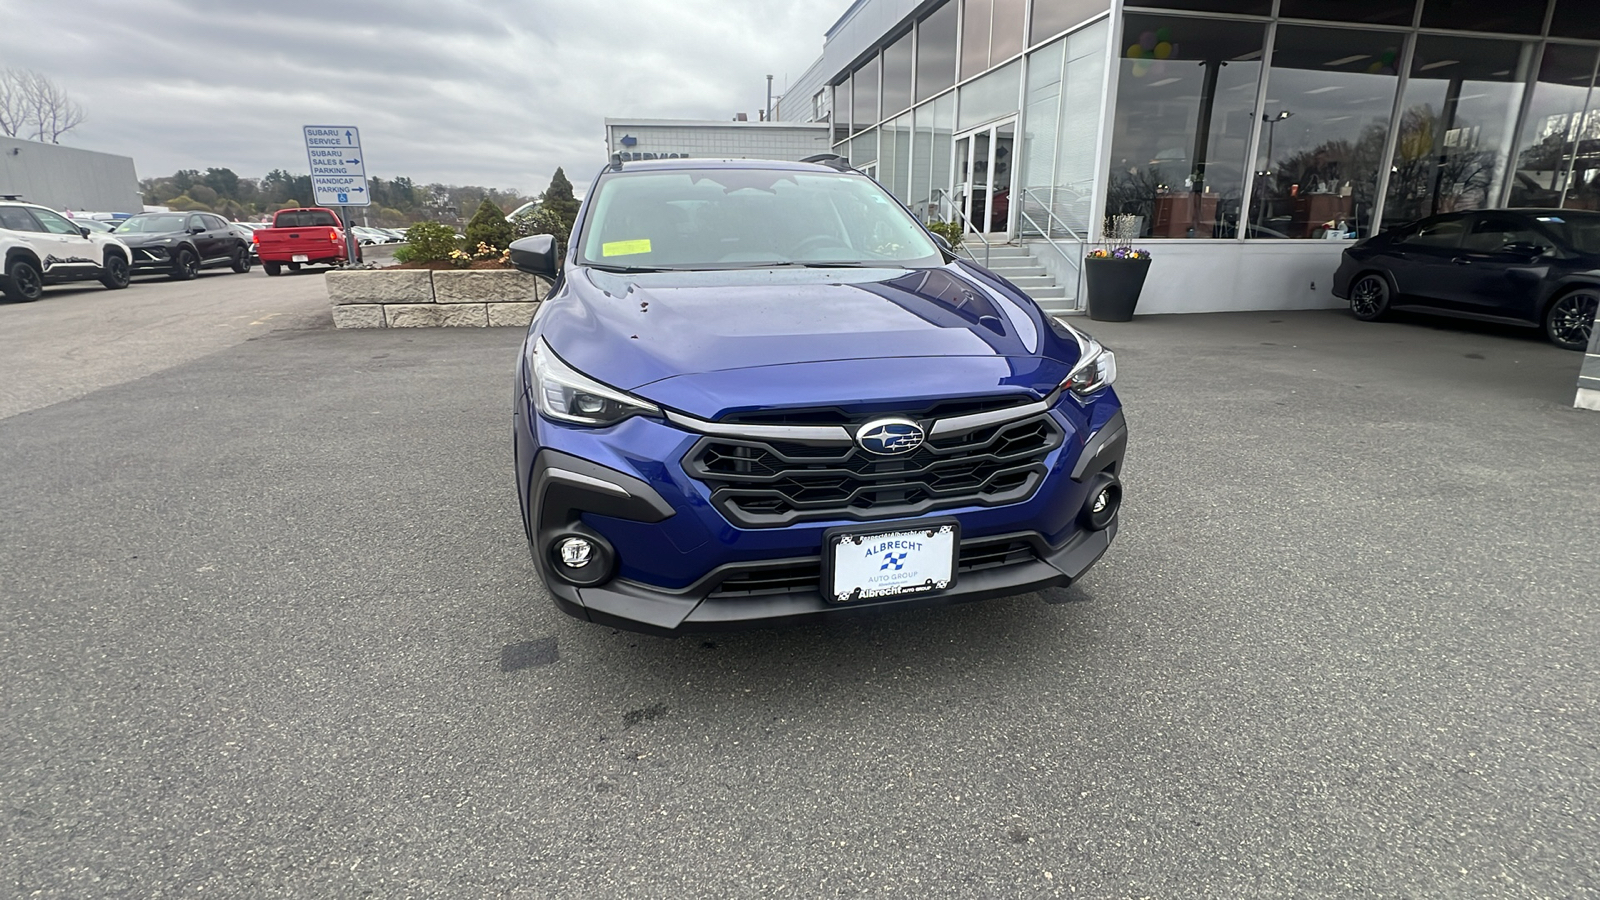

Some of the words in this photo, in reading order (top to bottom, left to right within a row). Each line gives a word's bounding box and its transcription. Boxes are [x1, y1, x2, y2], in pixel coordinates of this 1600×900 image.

[865, 541, 922, 557] ALBRECHT
[868, 575, 890, 583] AUTO
[891, 571, 918, 580] GROUP
[858, 585, 902, 599] Albrecht
